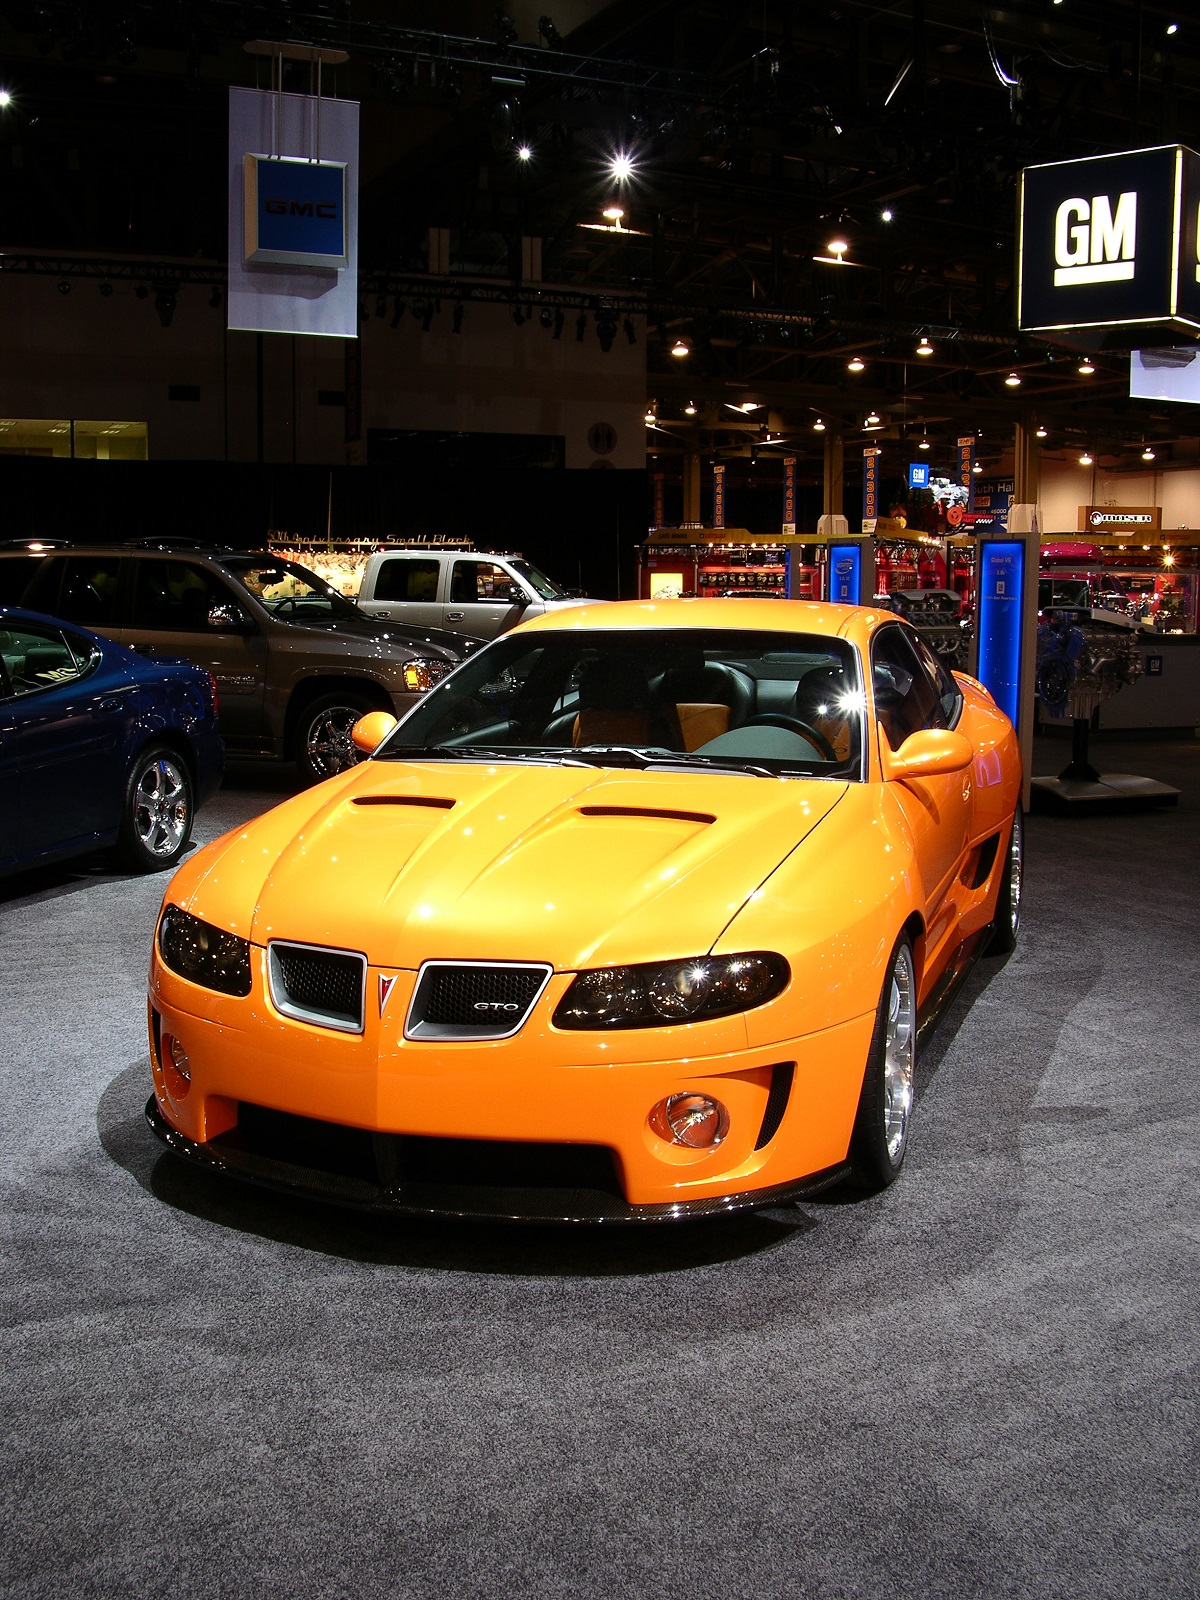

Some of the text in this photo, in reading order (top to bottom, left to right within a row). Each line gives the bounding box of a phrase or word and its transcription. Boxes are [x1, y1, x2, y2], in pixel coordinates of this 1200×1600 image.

[266, 198, 337, 218] GMC
[1054, 191, 1137, 267] GM
[913, 469, 925, 479] GM
[785, 465, 793, 521] 24400
[866, 456, 875, 517] 24300
[974, 482, 1014, 495] outh Hal
[293, 533, 379, 551] Anniversary
[387, 534, 427, 543] Small
[433, 534, 471, 544] Block
[1151, 660, 1160, 668] GM
[473, 1002, 519, 1011] GTO
